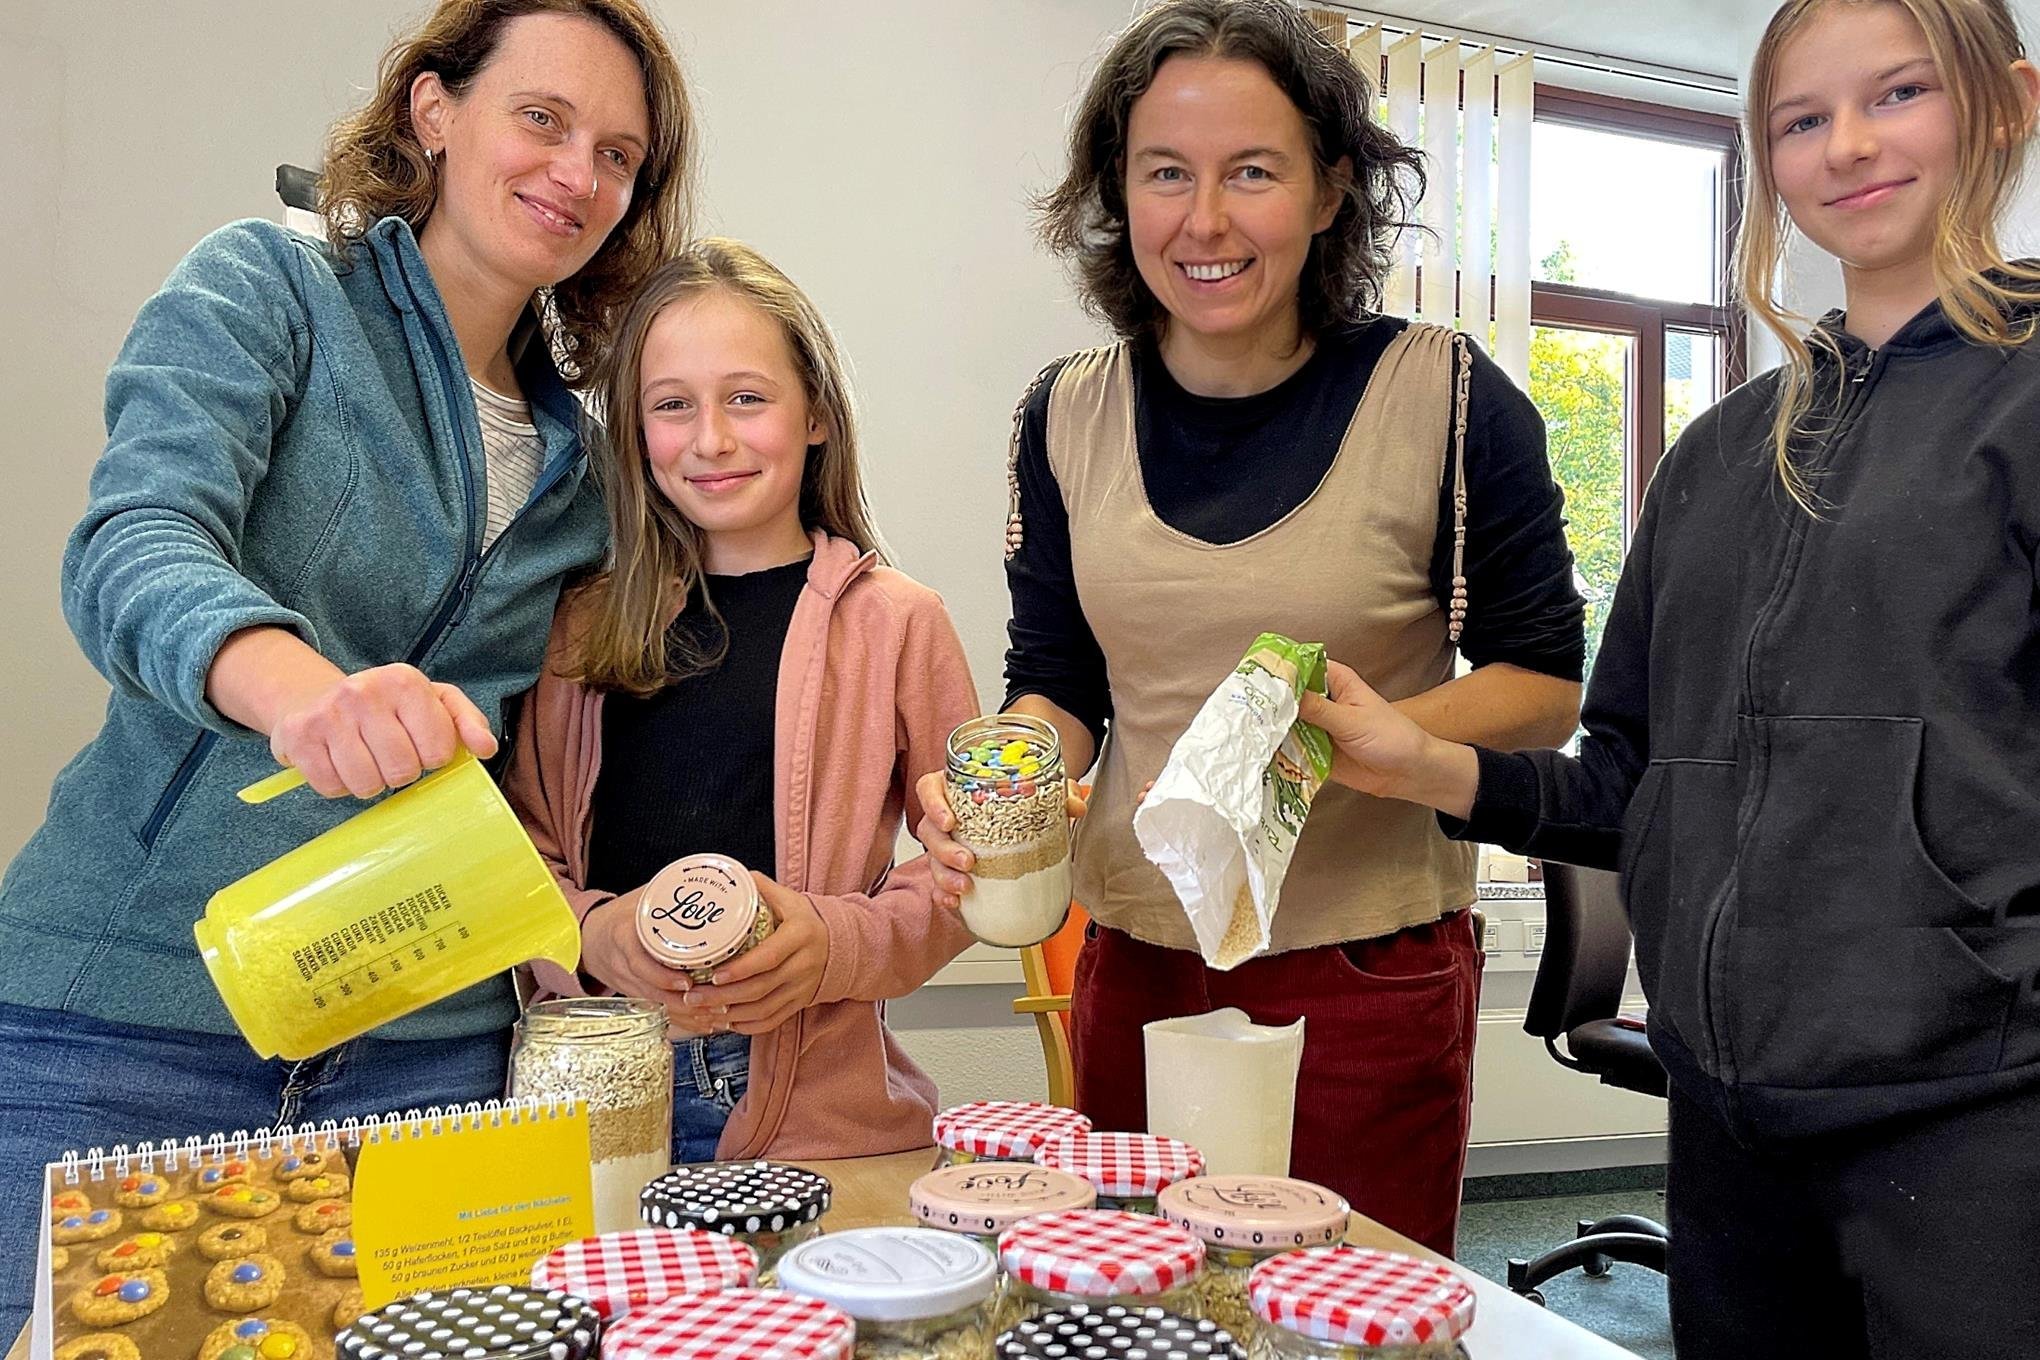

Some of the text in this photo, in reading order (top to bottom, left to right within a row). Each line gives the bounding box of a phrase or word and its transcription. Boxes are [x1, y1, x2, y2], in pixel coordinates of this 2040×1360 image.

[424, 887, 442, 912] SUGAR
[433, 883, 452, 910] ZUCKER
[710, 880, 726, 893] WITH
[651, 886, 725, 930] Love
[377, 911, 396, 936] SUIKER
[320, 936, 340, 964] SOCKER
[434, 938, 447, 951] 700
[302, 945, 321, 973] SUKKER
[368, 971, 380, 984] 400
[314, 996, 327, 1009] 200
[374, 1250, 389, 1260] 135
[400, 1237, 454, 1253] Weizenmehl,
[458, 1233, 471, 1244] 1/2
[508, 1221, 554, 1235] Backpulver,
[404, 1251, 459, 1267] Haferflocken,
[493, 1239, 512, 1253] Salz
[512, 1235, 529, 1248] und
[412, 1263, 449, 1279] braunen
[449, 1258, 480, 1272] Zucker
[480, 1253, 498, 1266] und
